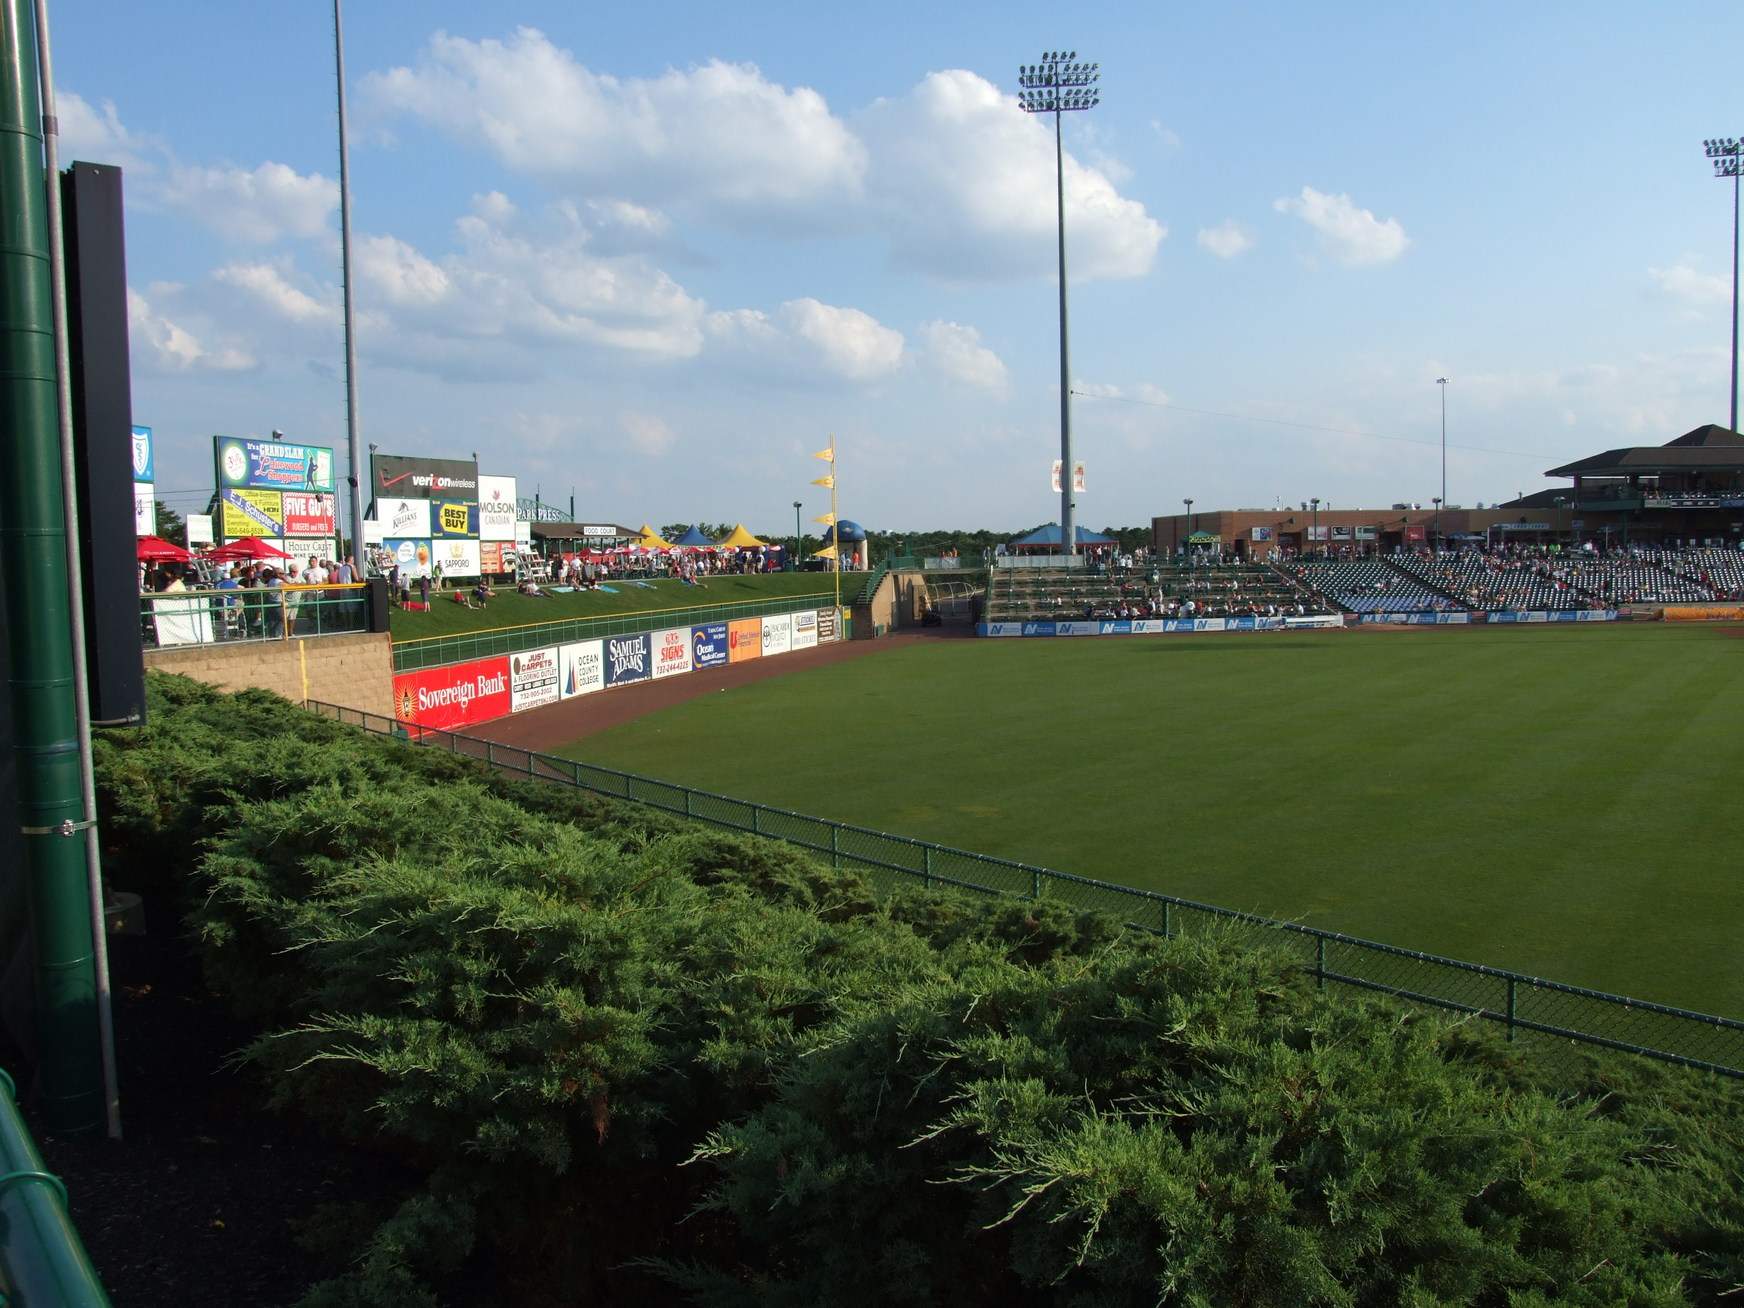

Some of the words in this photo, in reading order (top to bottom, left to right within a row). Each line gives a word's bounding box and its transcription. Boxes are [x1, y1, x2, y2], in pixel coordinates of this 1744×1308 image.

[260, 444, 286, 458] GRAND
[286, 447, 304, 459] SLAM
[255, 455, 304, 476] Lakewood
[268, 470, 304, 484] Shoppers
[412, 474, 451, 490] verizon
[451, 479, 476, 488] wireless
[286, 498, 306, 516] FIVE
[308, 498, 333, 516] GUYS
[480, 502, 514, 513] MOLSON
[444, 508, 466, 520] BEST
[485, 515, 510, 525] CANADIAN
[538, 508, 560, 520] PRESS
[446, 519, 465, 529] BUY
[288, 542, 310, 551] HOLLY
[445, 560, 469, 568] SAPPORO
[610, 636, 646, 661] SAMUEL
[660, 644, 684, 663] SIGNS
[696, 643, 714, 656] Ocean
[528, 652, 545, 662] JUST
[578, 654, 599, 666] OCEAN
[521, 659, 553, 672] CARPETS
[579, 665, 599, 676] COUNTY
[612, 654, 643, 681] ADAMS
[519, 672, 540, 682] FLOORING
[541, 668, 557, 677] OUTLET
[579, 675, 599, 686] COLLEGE
[418, 680, 476, 710] Sovereign
[478, 672, 505, 698] Bank
